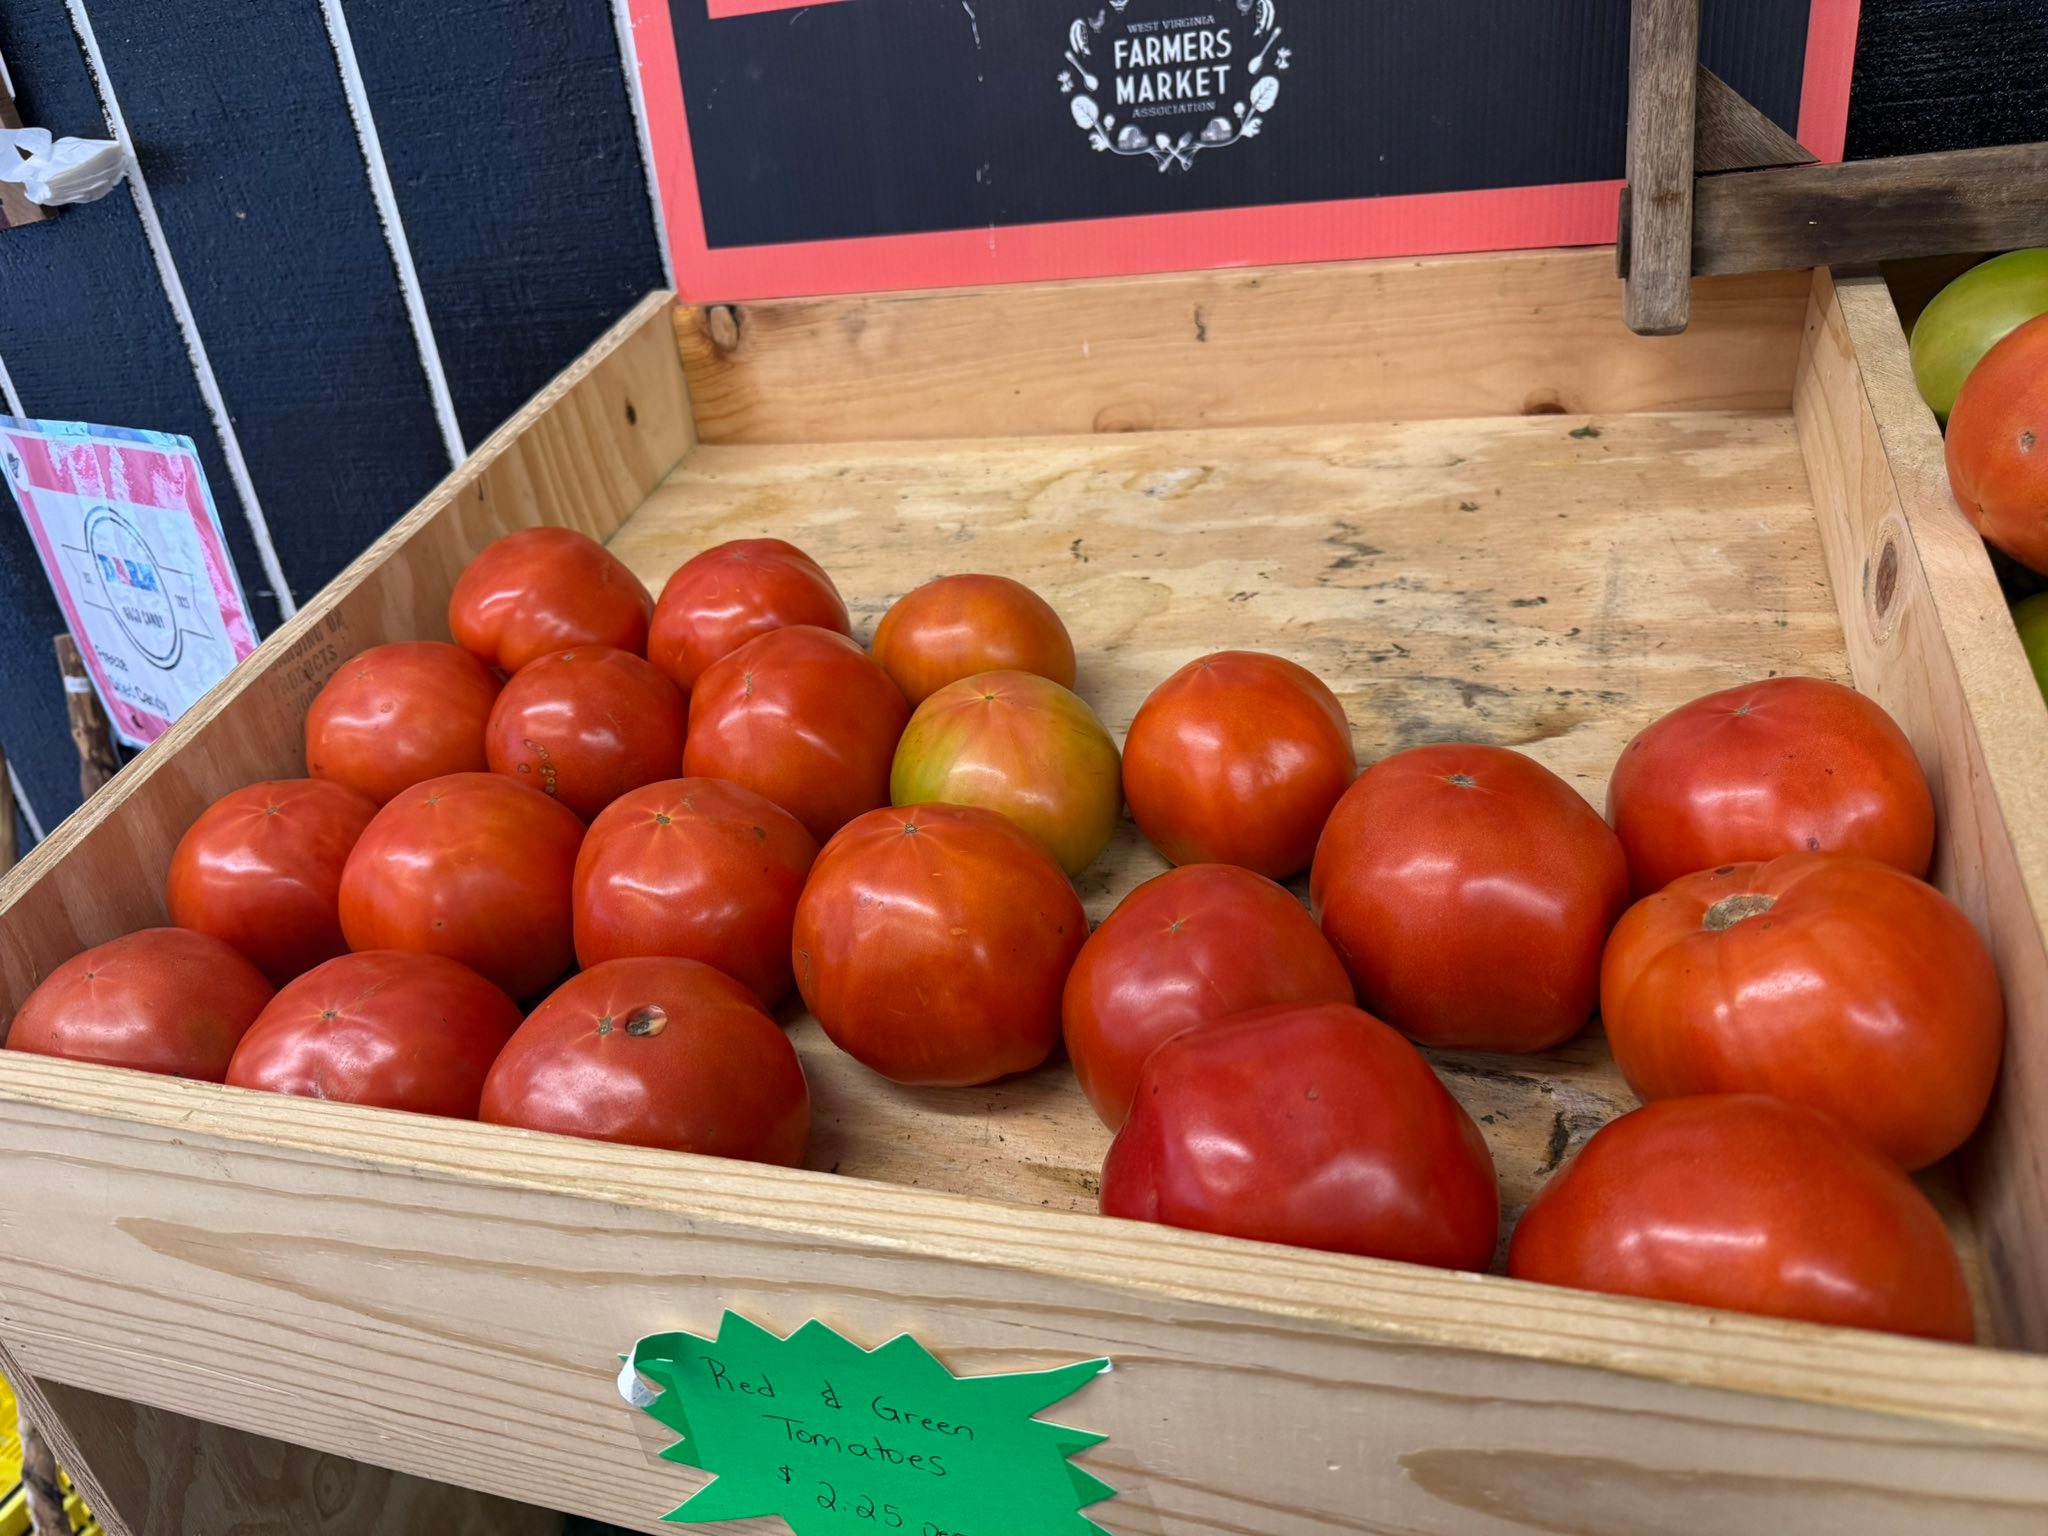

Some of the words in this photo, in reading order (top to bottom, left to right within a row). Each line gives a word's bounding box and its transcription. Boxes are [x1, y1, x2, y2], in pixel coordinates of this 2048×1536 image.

[1126, 21, 1160, 34] WEST
[1162, 14, 1216, 30] VIRGINIA
[1113, 28, 1233, 70] FARMERS
[1115, 64, 1231, 105] MARKET
[1132, 101, 1216, 118] ASSOCIATION
[700, 1356, 776, 1398] Red
[871, 1395, 974, 1441] Green
[761, 1413, 947, 1477] Tomatoes
[816, 1481, 903, 1527] 2.25
